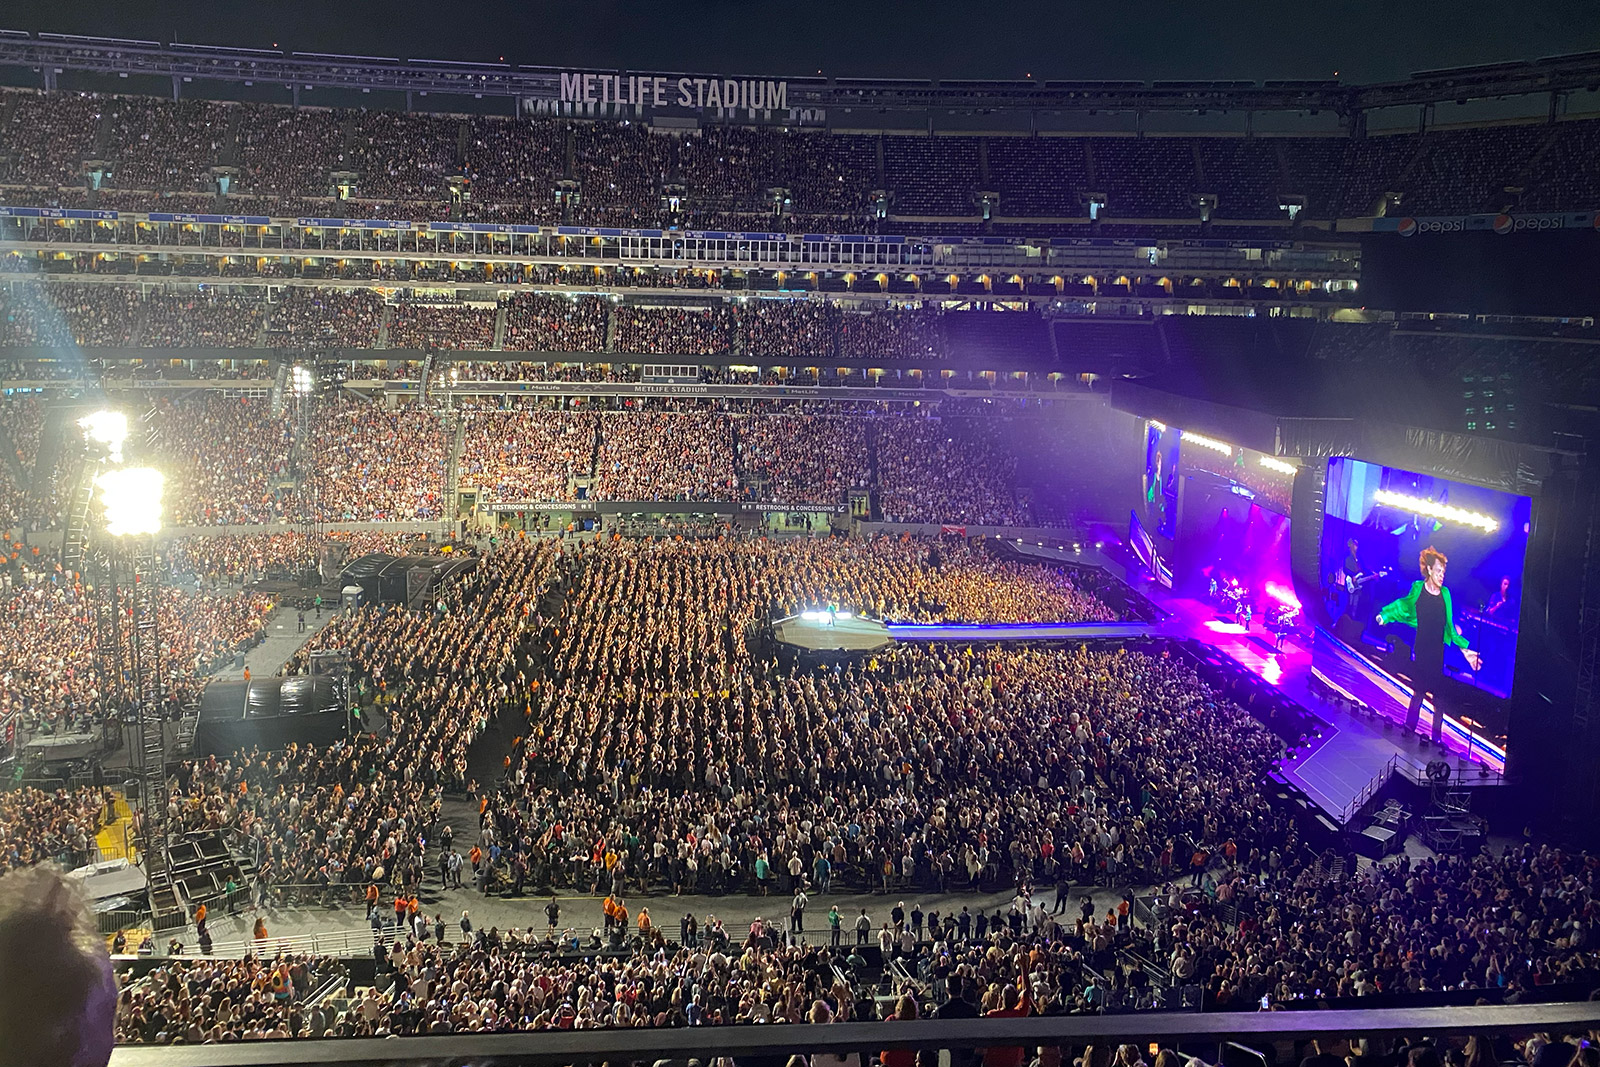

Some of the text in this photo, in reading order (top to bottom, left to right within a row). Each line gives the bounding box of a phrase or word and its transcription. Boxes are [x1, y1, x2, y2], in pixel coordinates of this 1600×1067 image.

[560, 73, 668, 106] METLIFE
[677, 78, 788, 110] STADIUM
[1418, 219, 1466, 234] pepsi
[1513, 215, 1565, 232] pepsi
